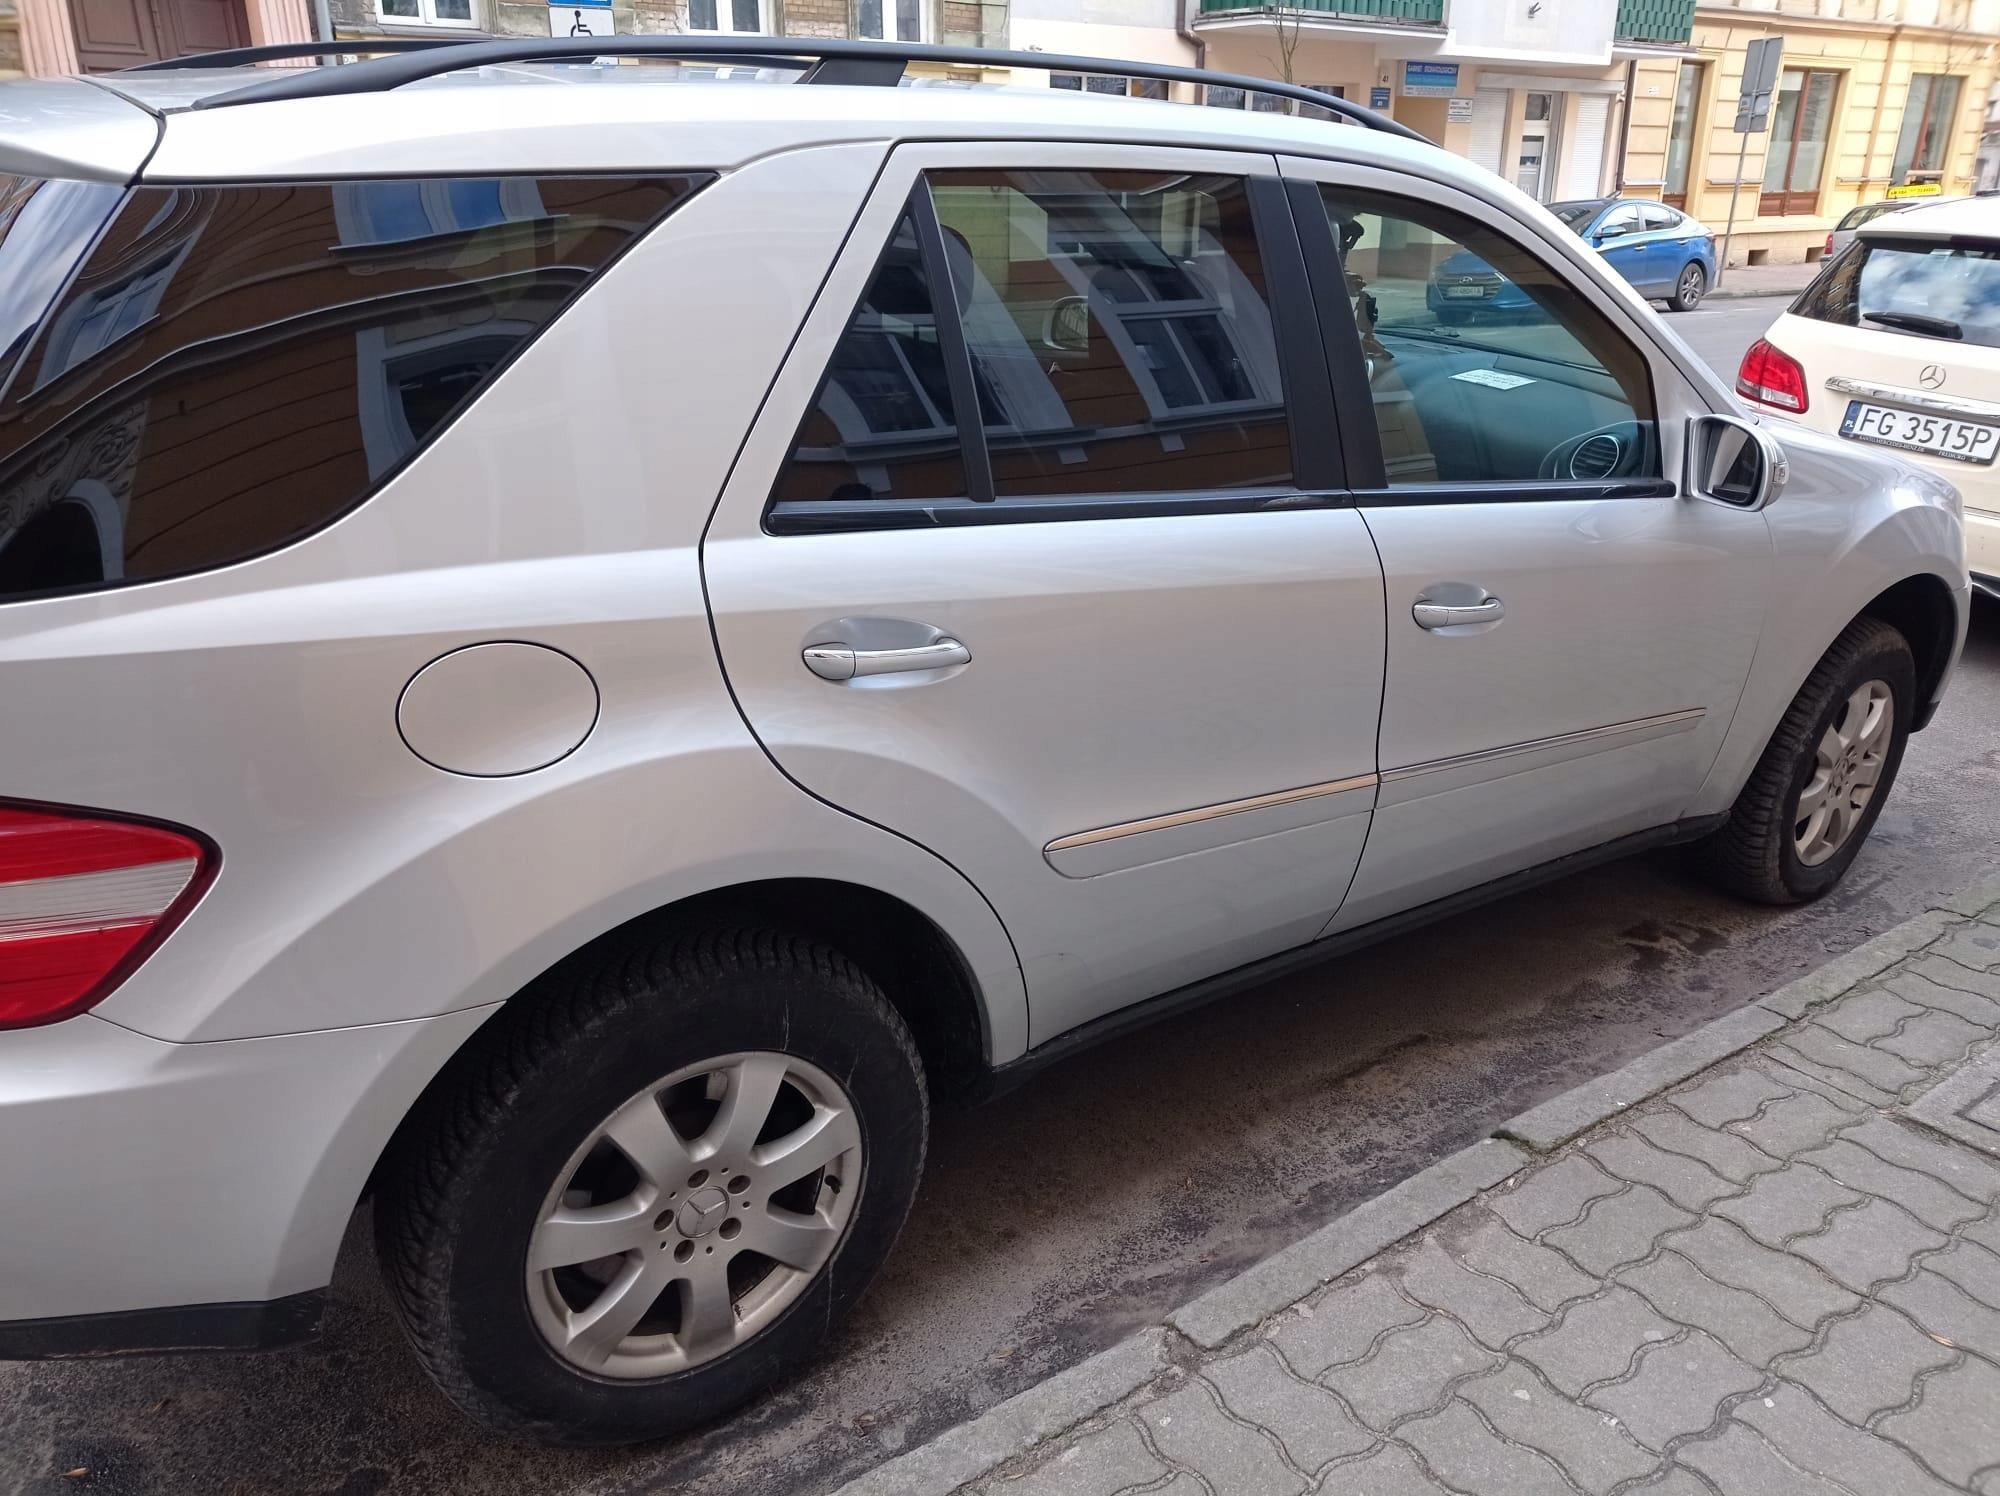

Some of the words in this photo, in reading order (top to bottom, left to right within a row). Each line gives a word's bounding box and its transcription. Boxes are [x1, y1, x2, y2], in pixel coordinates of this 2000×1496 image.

[1844, 420, 1855, 429] PL
[1859, 408, 1897, 436] FG
[1902, 416, 1993, 453] 3515P
